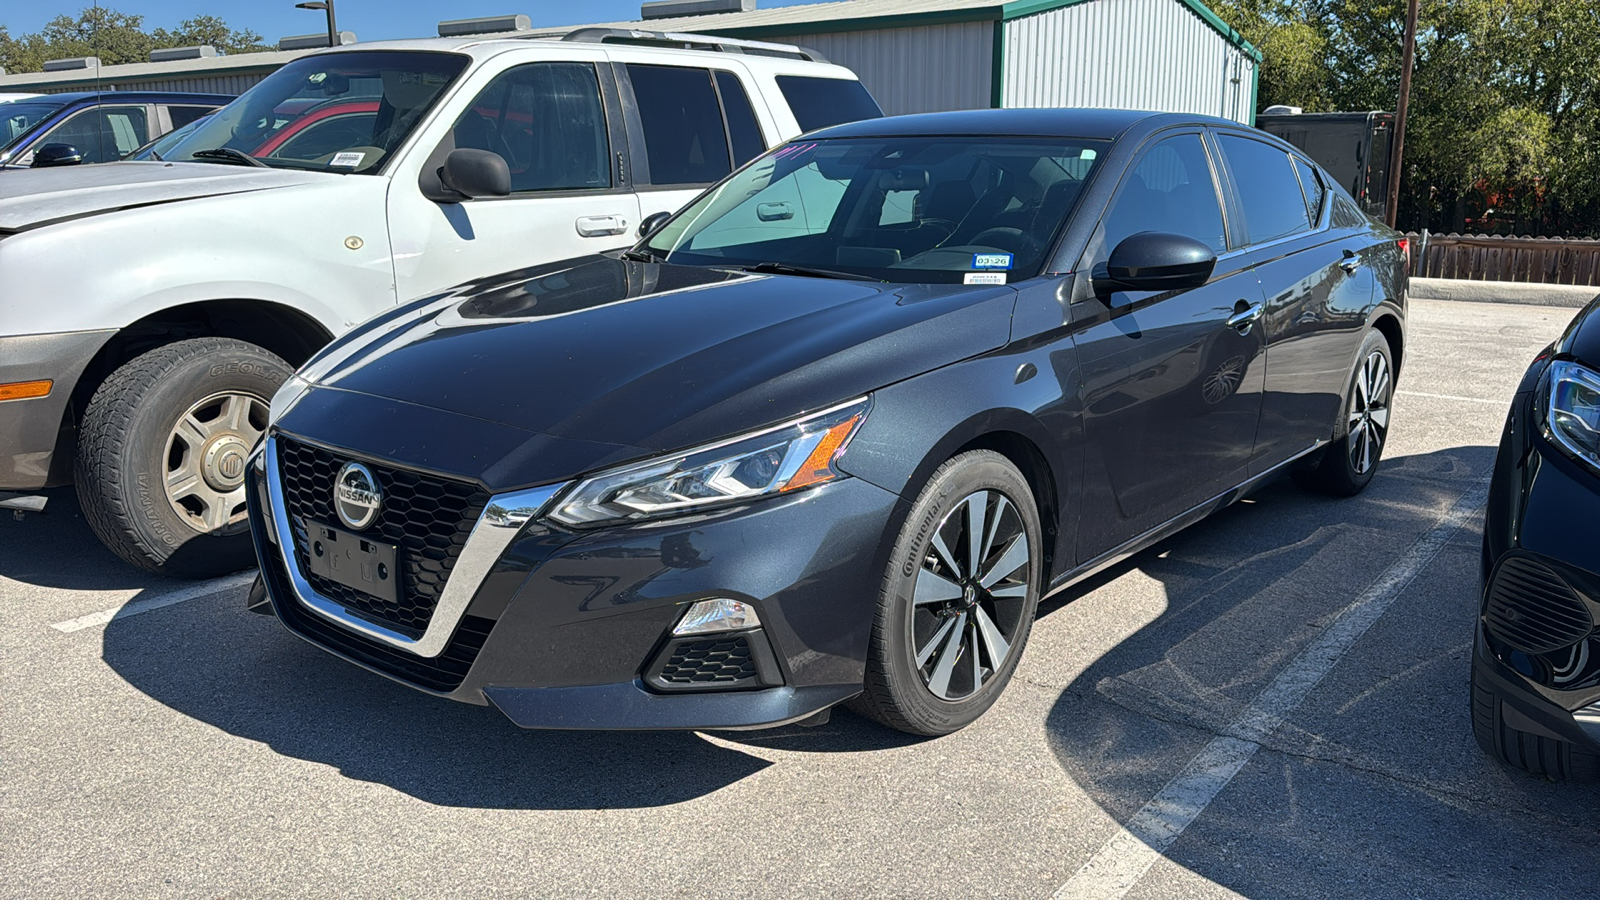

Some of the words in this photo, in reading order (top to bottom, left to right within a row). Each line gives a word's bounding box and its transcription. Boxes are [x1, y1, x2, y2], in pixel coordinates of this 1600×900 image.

[210, 362, 283, 386] GEOLA
[137, 472, 179, 549] OHAMA
[339, 486, 373, 505] NISSAN
[902, 499, 944, 578] Continental
